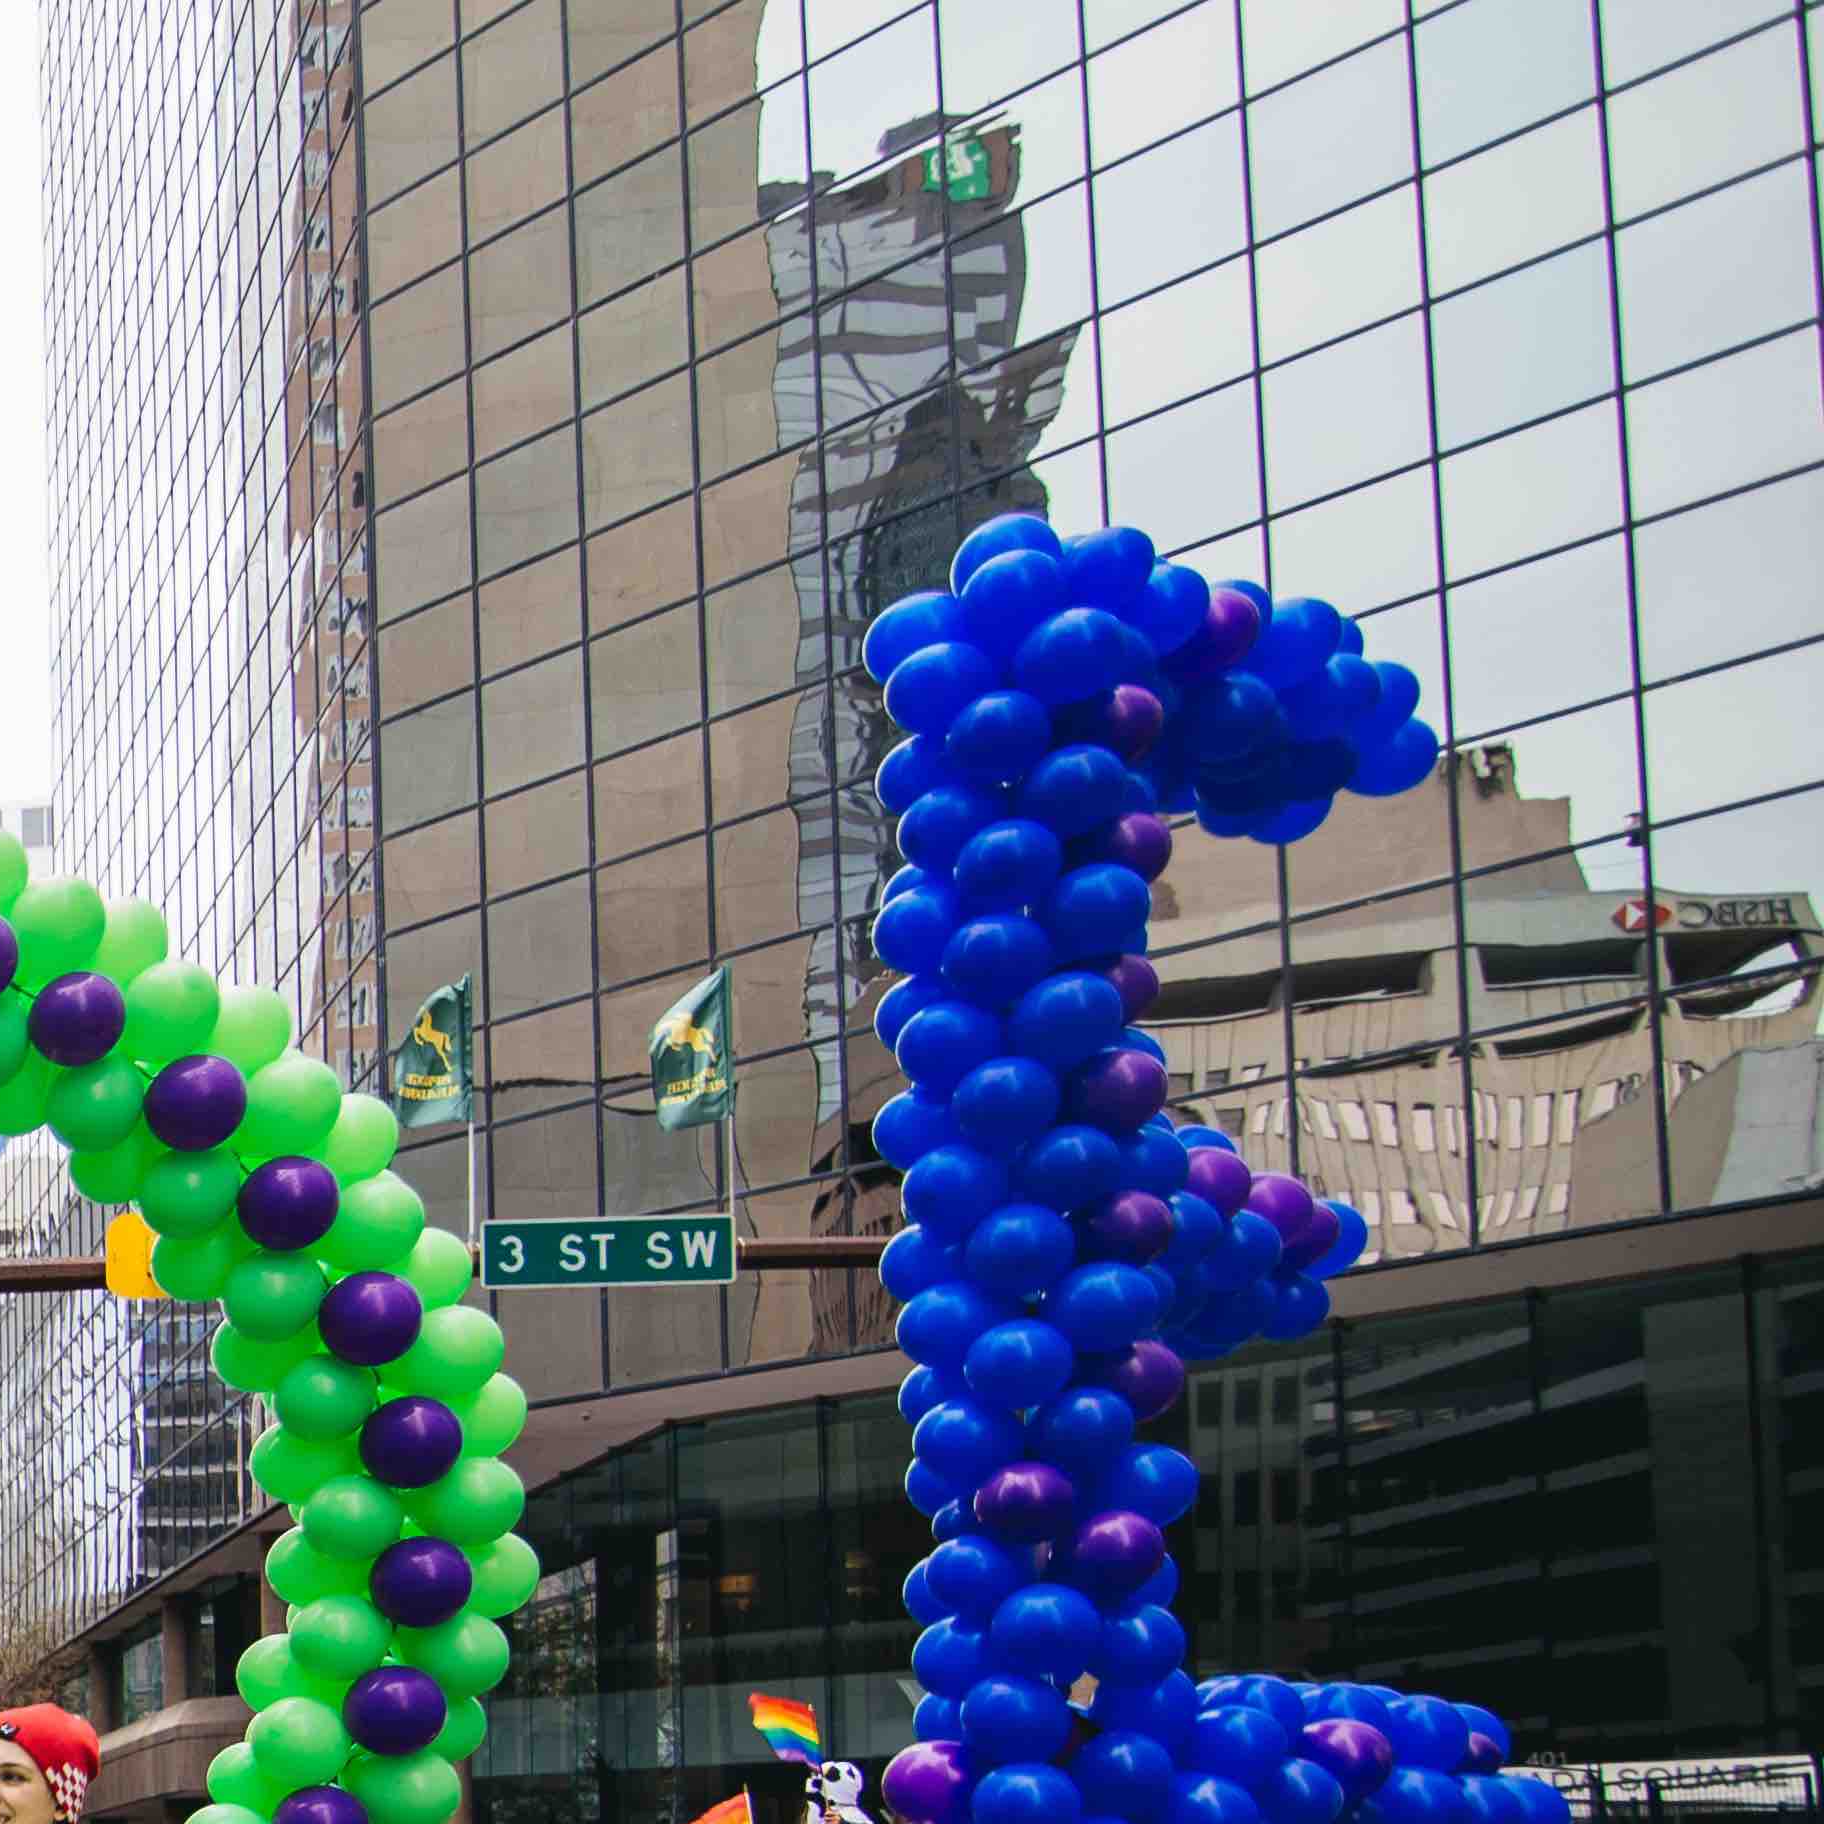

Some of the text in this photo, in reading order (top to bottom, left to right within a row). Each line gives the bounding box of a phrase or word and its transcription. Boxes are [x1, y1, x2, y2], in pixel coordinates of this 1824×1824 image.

[498, 1230, 717, 1273] 3 ST SW
[1616, 1763, 1790, 1791] SQUARE
